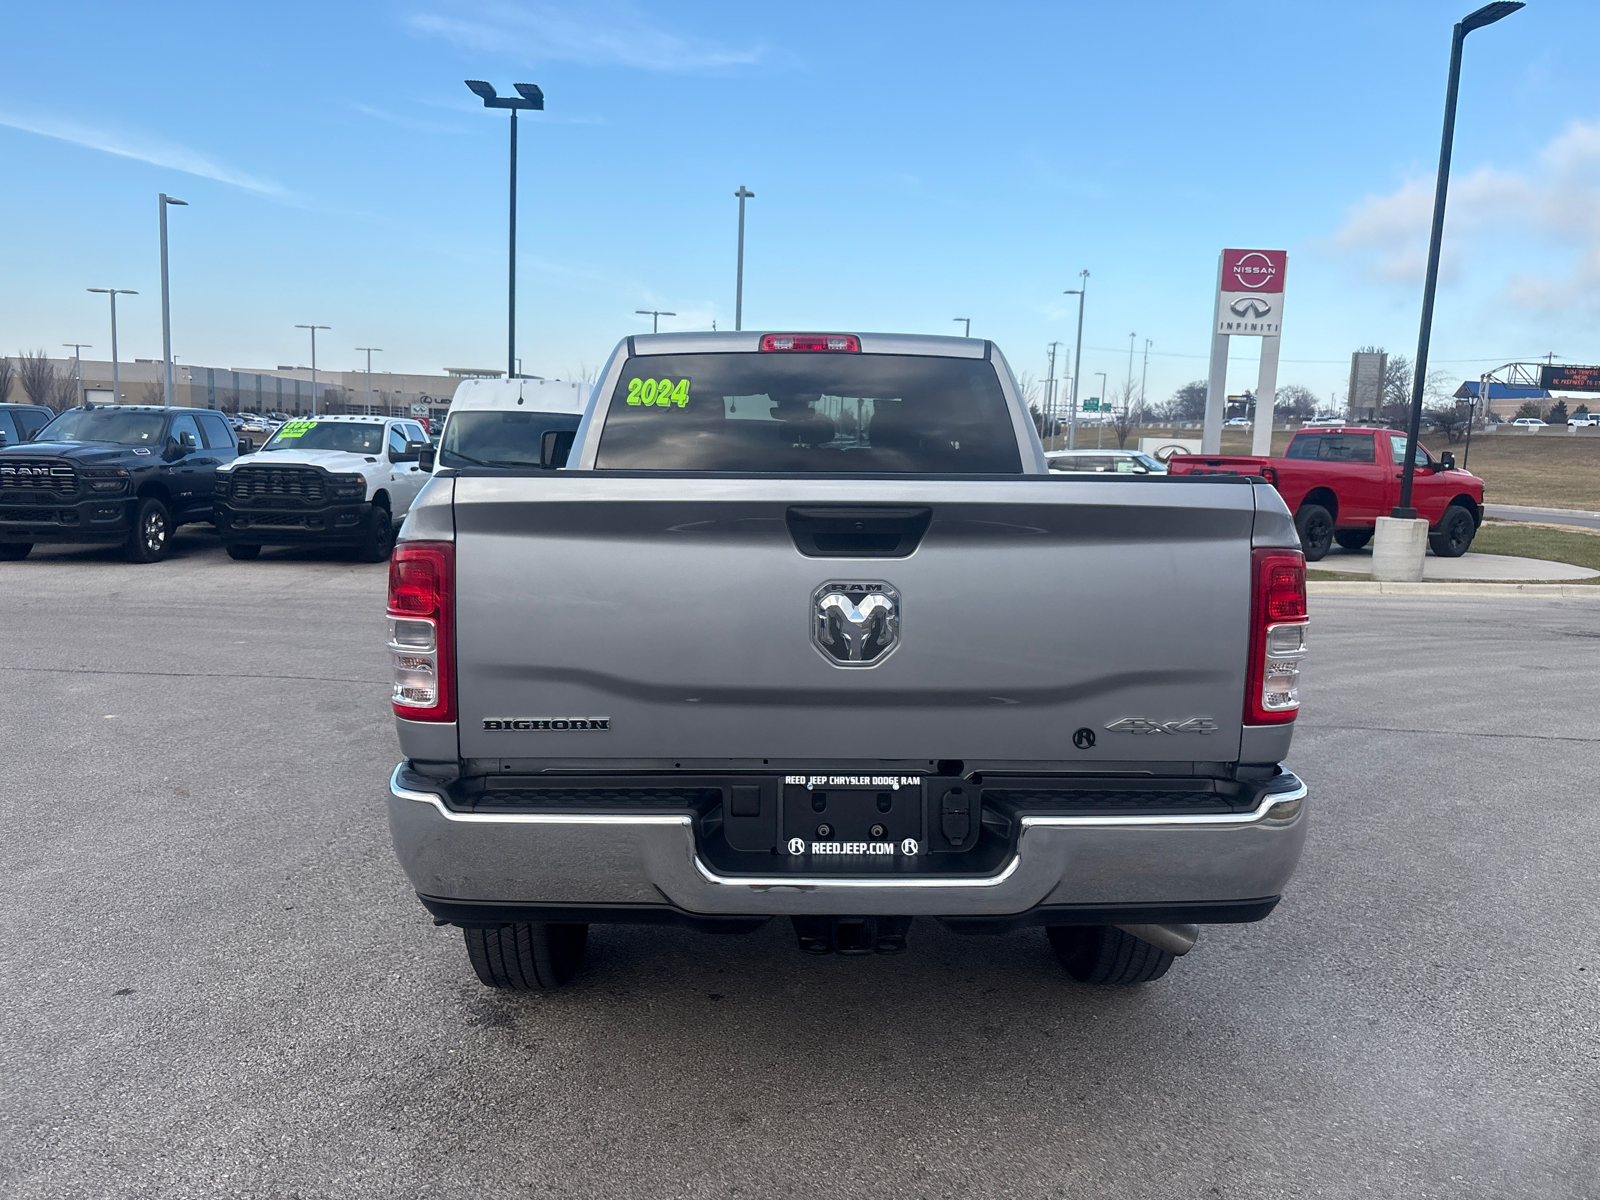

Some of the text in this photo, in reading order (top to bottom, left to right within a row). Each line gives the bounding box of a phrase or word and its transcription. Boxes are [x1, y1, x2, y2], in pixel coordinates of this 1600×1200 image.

[1233, 266, 1276, 274] NISSAN
[1220, 321, 1278, 332] INFINITI
[626, 377, 691, 408] 2024
[0, 467, 49, 475] RAM
[482, 716, 611, 732] BIGHORN
[785, 775, 921, 785] REED JEEP CHRYSLER DODGE RAM
[811, 842, 894, 855] REEDJEEP.COM
